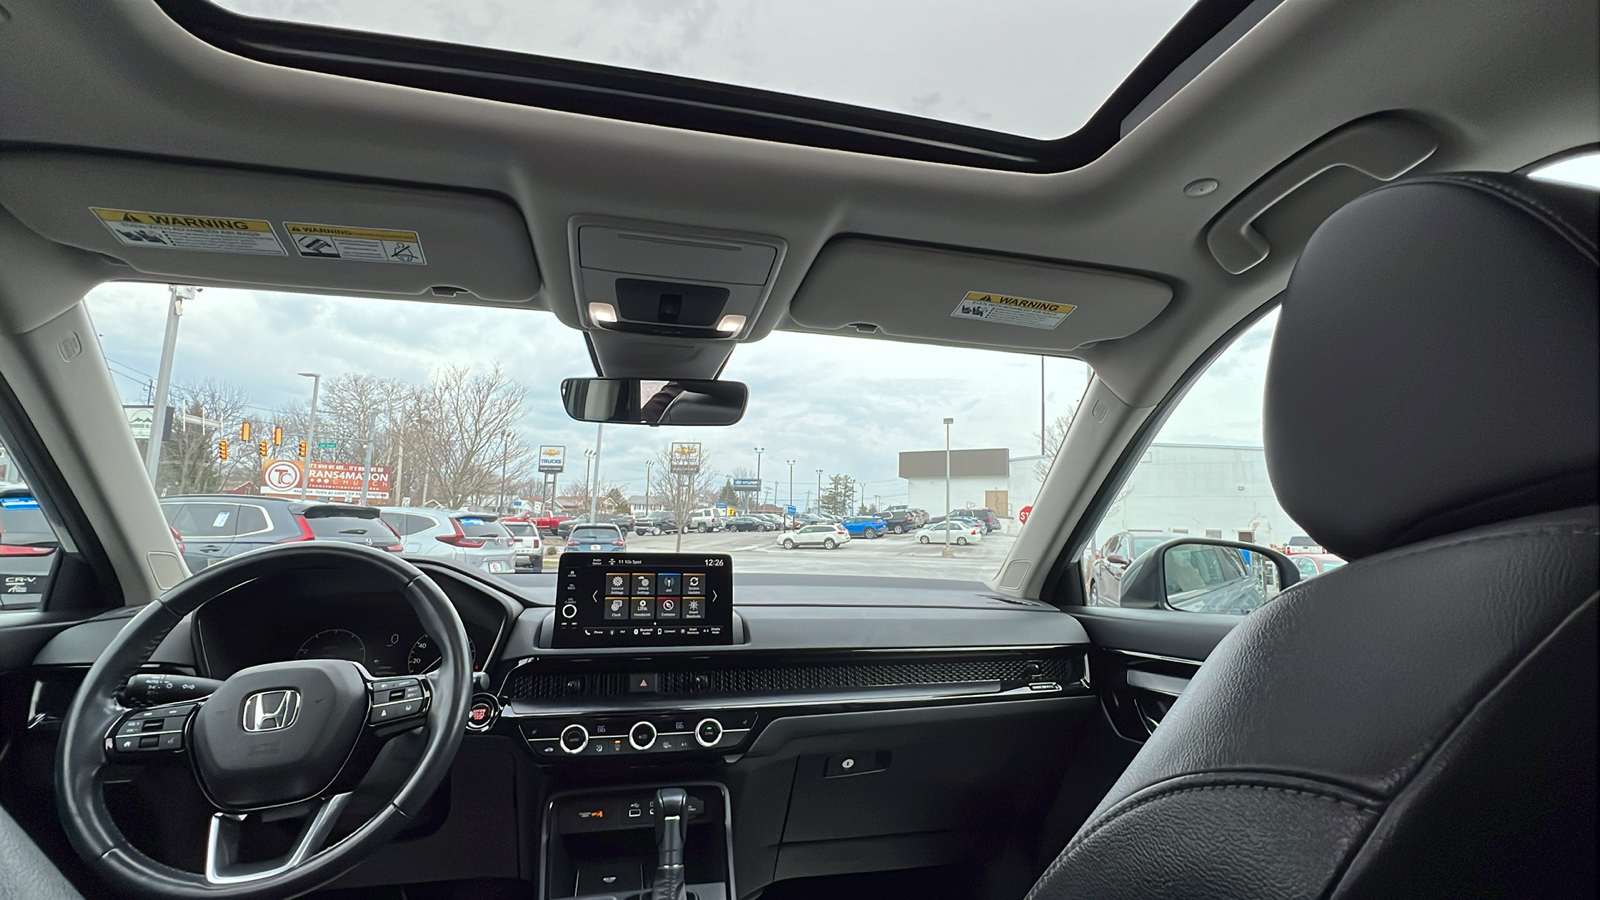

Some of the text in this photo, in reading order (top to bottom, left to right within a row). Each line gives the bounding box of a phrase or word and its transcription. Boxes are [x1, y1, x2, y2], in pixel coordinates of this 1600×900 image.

[149, 215, 249, 230] WARNING
[302, 227, 352, 236] WARNING
[1000, 297, 1060, 312] WARNING
[308, 469, 388, 482] RANS4MAION
[332, 478, 388, 487] CHUCH
[704, 559, 724, 567] 12:26
